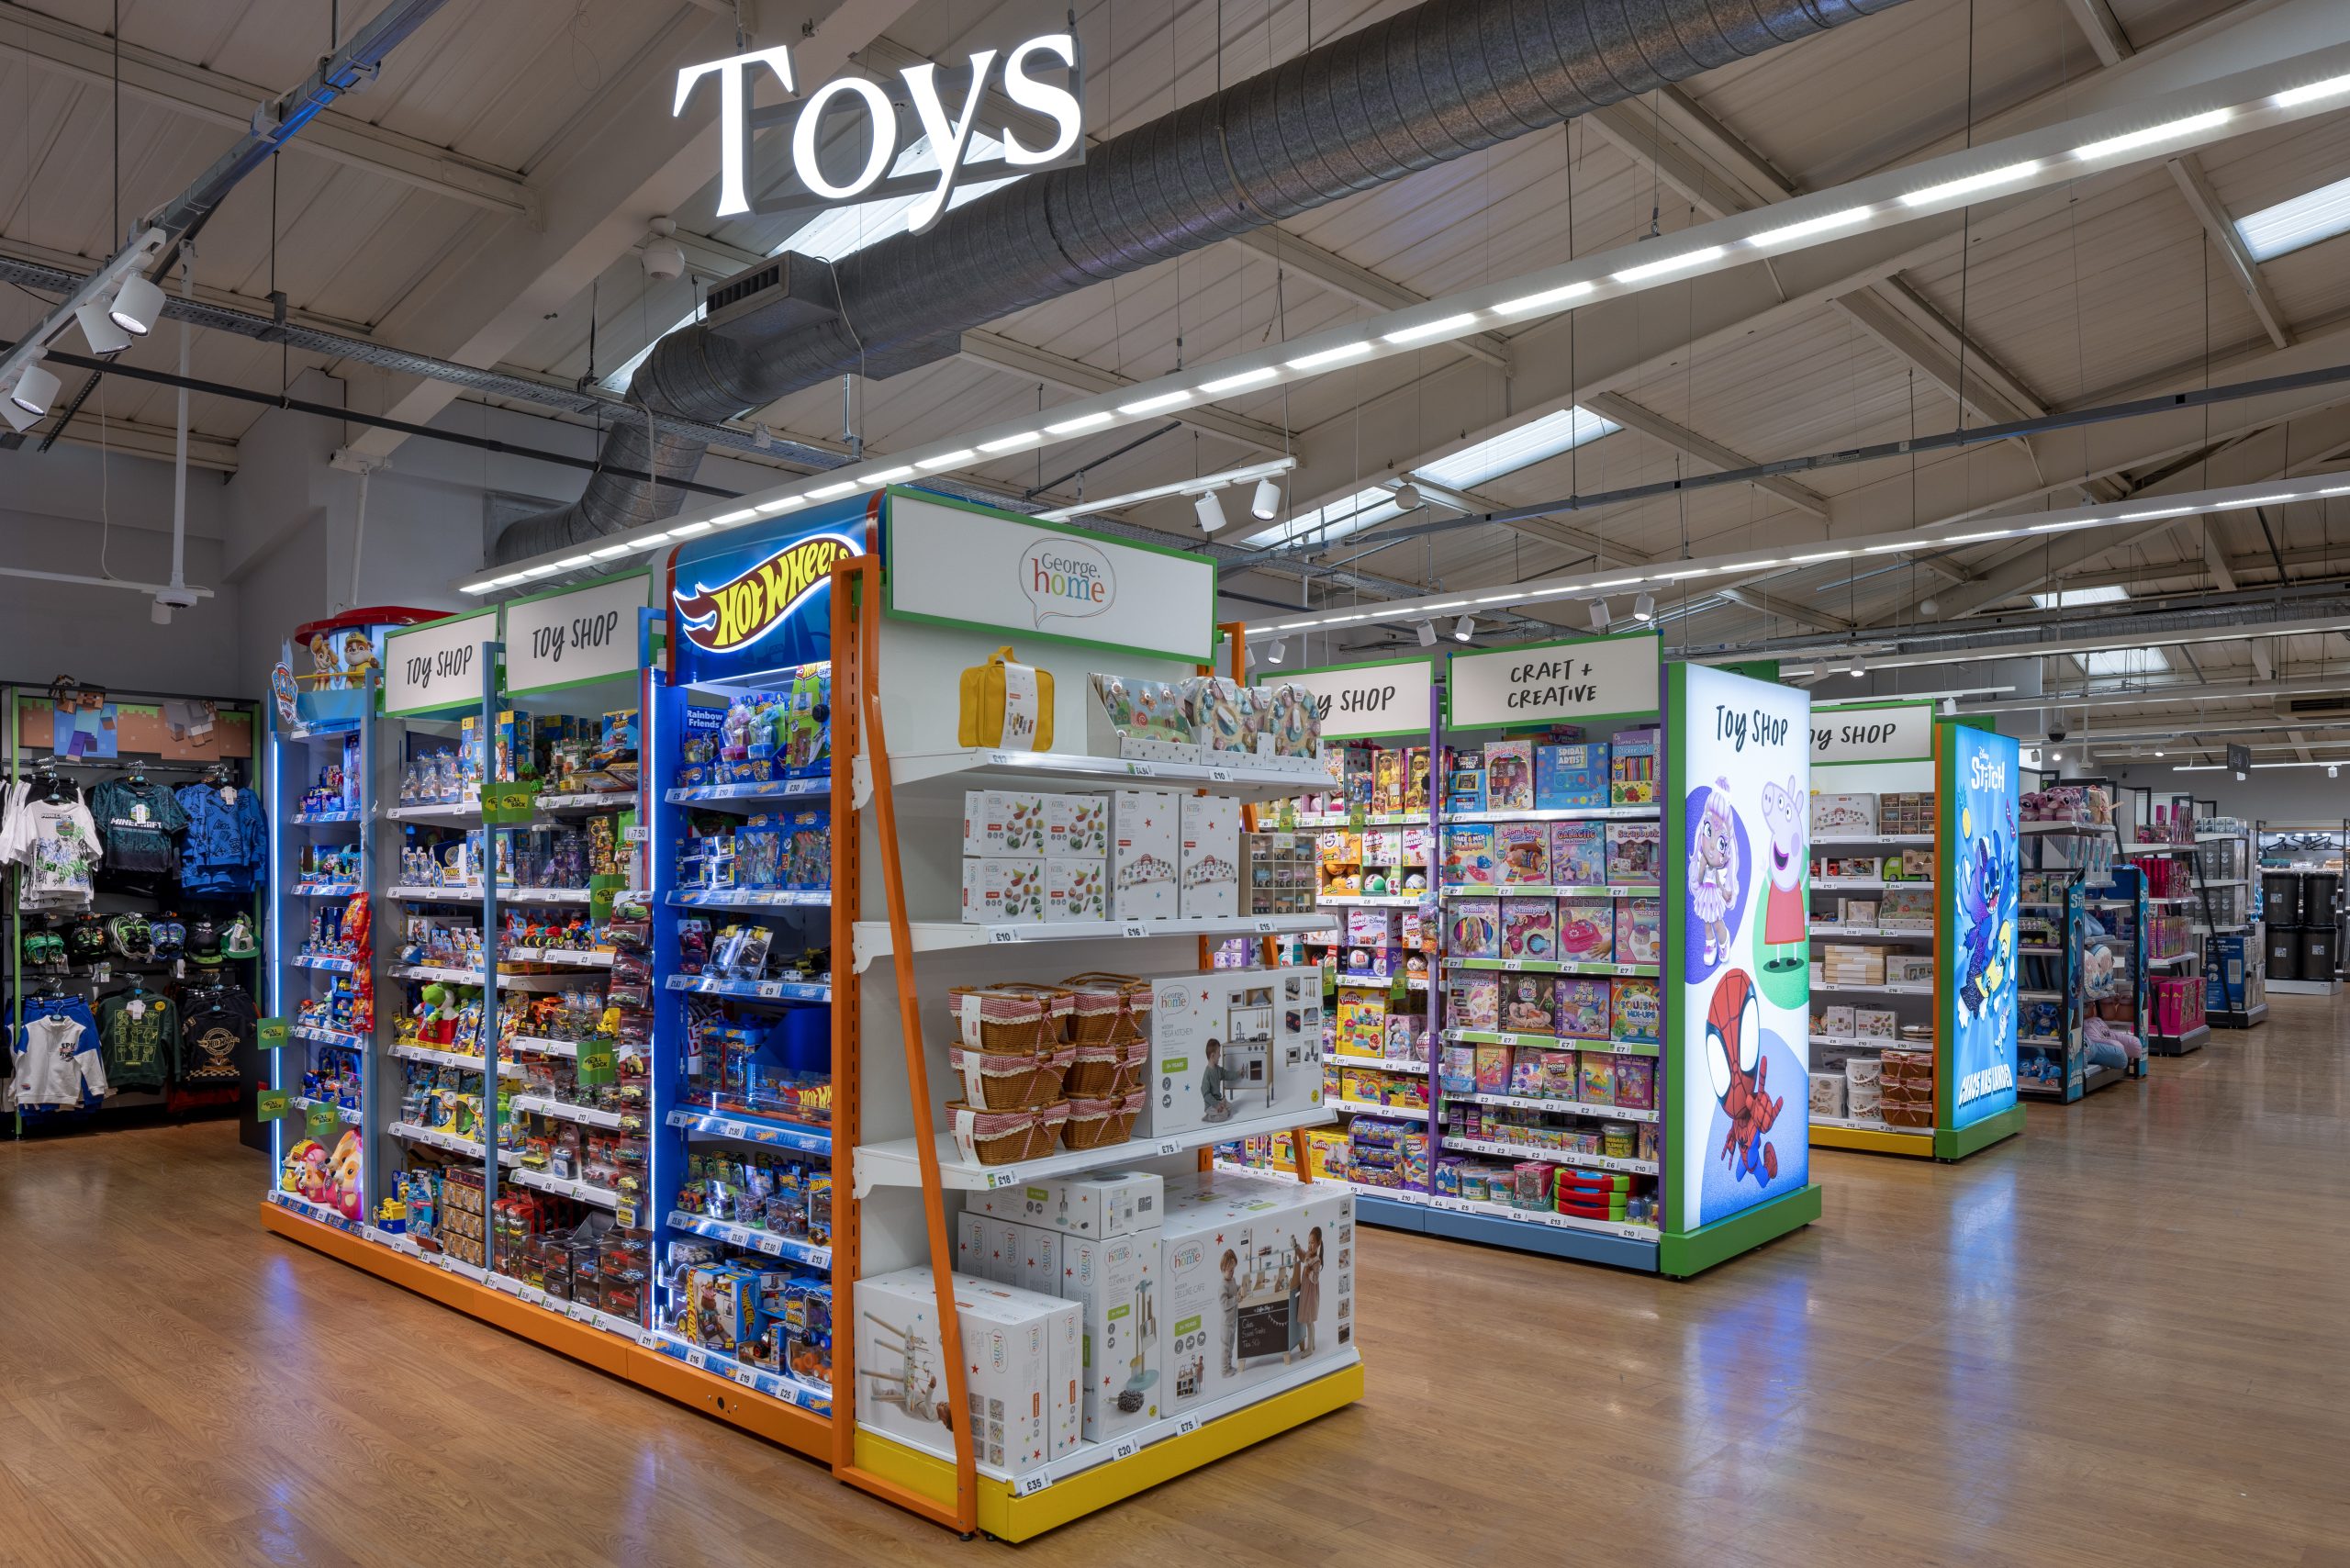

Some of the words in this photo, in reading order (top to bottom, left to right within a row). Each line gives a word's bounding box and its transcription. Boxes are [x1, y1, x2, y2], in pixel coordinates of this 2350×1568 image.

[672, 34, 1081, 237] Toys
[1032, 558, 1105, 603] home
[710, 580, 764, 645] HOT
[532, 626, 565, 662] TOY
[571, 610, 618, 649] SHOP
[406, 655, 431, 689] TOY
[437, 644, 473, 678] SHOP
[1510, 659, 1574, 683] CRAFT
[1581, 664, 1593, 676] +
[1340, 686, 1395, 712] SHOP
[1507, 685, 1596, 708] CREATIVE
[688, 711, 722, 721] Rainbow
[688, 719, 720, 728] Friends
[1752, 710, 1788, 746] SHOP
[1841, 723, 1897, 744] SHOP
[1558, 756, 1583, 764] ARTIST
[1213, 772, 1225, 780] £10
[632, 829, 645, 838] £7.50
[1502, 829, 1520, 838] Loom
[1524, 828, 1542, 837] Band
[1558, 829, 1595, 839] GALACTIC
[1618, 827, 1660, 839] Scrapbook
[996, 932, 1011, 941] £10
[1127, 926, 1140, 936] £16
[1161, 995, 1186, 1009] home
[1959, 1071, 1980, 1108] CHAOS
[1980, 1069, 1992, 1096] HAS
[1992, 1063, 2012, 1093] LANDED
[1161, 1144, 1174, 1154] £75
[998, 1174, 1012, 1185] £18
[812, 1255, 822, 1264] £13
[1108, 1249, 1130, 1263] home
[1175, 1253, 1201, 1268] home
[643, 1338, 651, 1346] £11
[992, 1334, 1001, 1368] home
[689, 1355, 699, 1364] £16
[740, 1373, 750, 1383] £19
[780, 1389, 791, 1398] £25
[1181, 1420, 1193, 1432] £75
[1118, 1445, 1131, 1456] £20
[1027, 1479, 1042, 1491] £35
